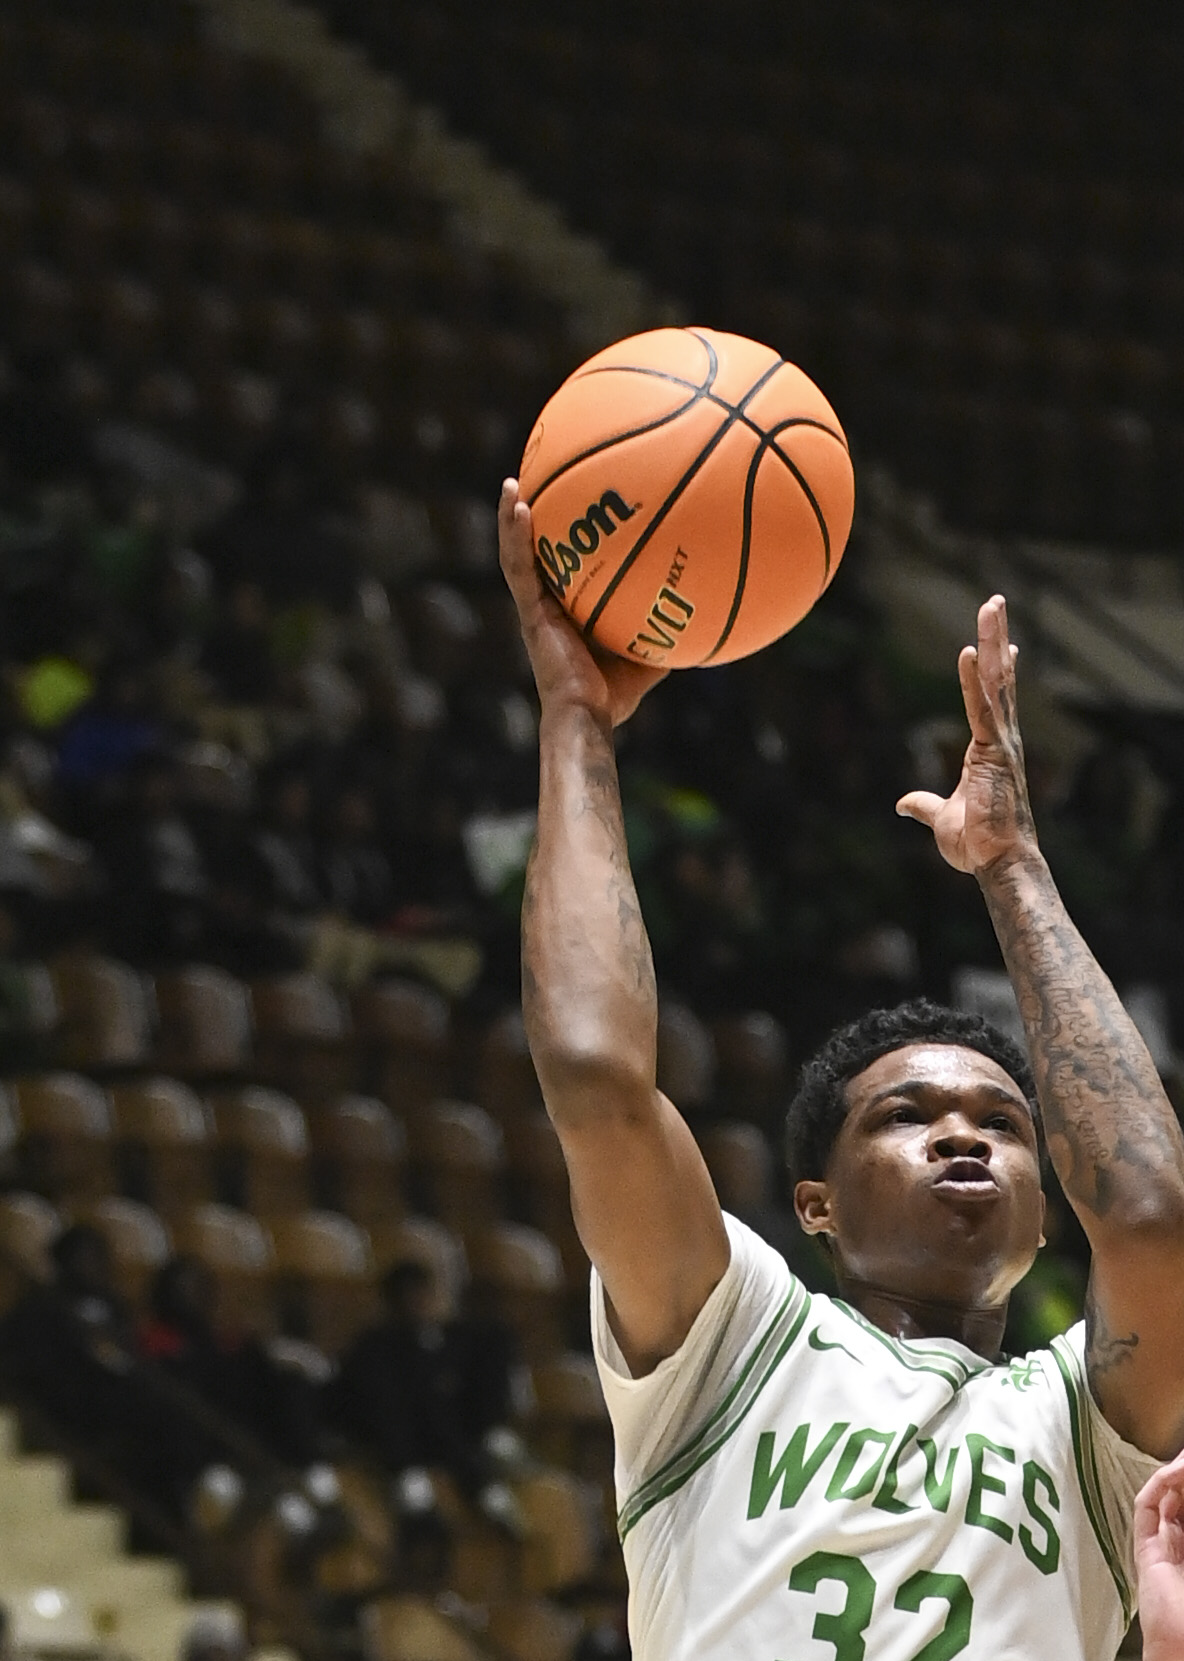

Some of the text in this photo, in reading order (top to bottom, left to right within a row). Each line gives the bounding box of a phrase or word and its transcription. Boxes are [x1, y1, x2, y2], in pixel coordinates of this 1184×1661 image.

[537, 488, 636, 600] lson
[626, 545, 695, 664] EVO NXT
[747, 1422, 1061, 1576] WOLVES
